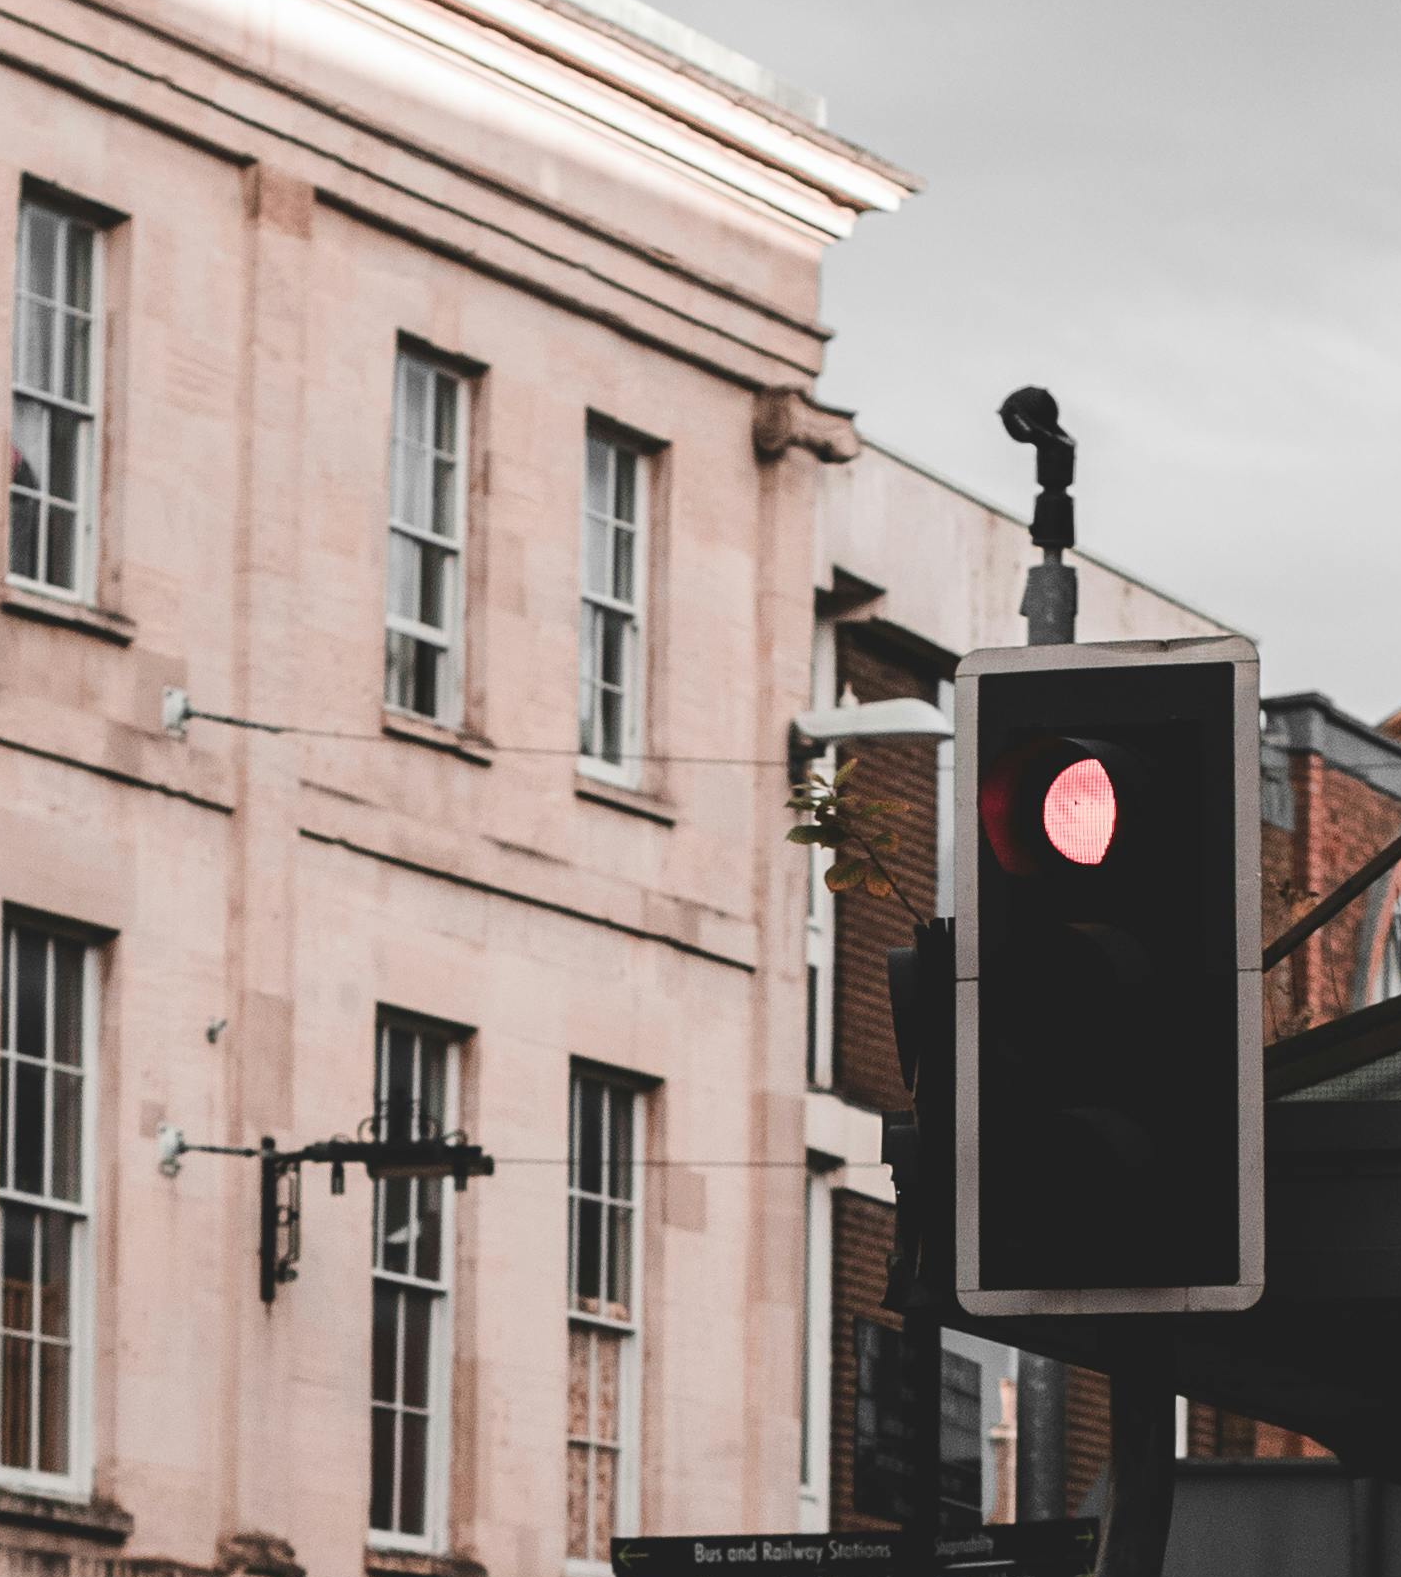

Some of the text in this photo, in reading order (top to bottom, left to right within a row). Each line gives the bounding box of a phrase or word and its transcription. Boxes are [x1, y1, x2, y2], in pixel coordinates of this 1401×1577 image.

[694, 1539, 891, 1565] Bus and Railway Stations
